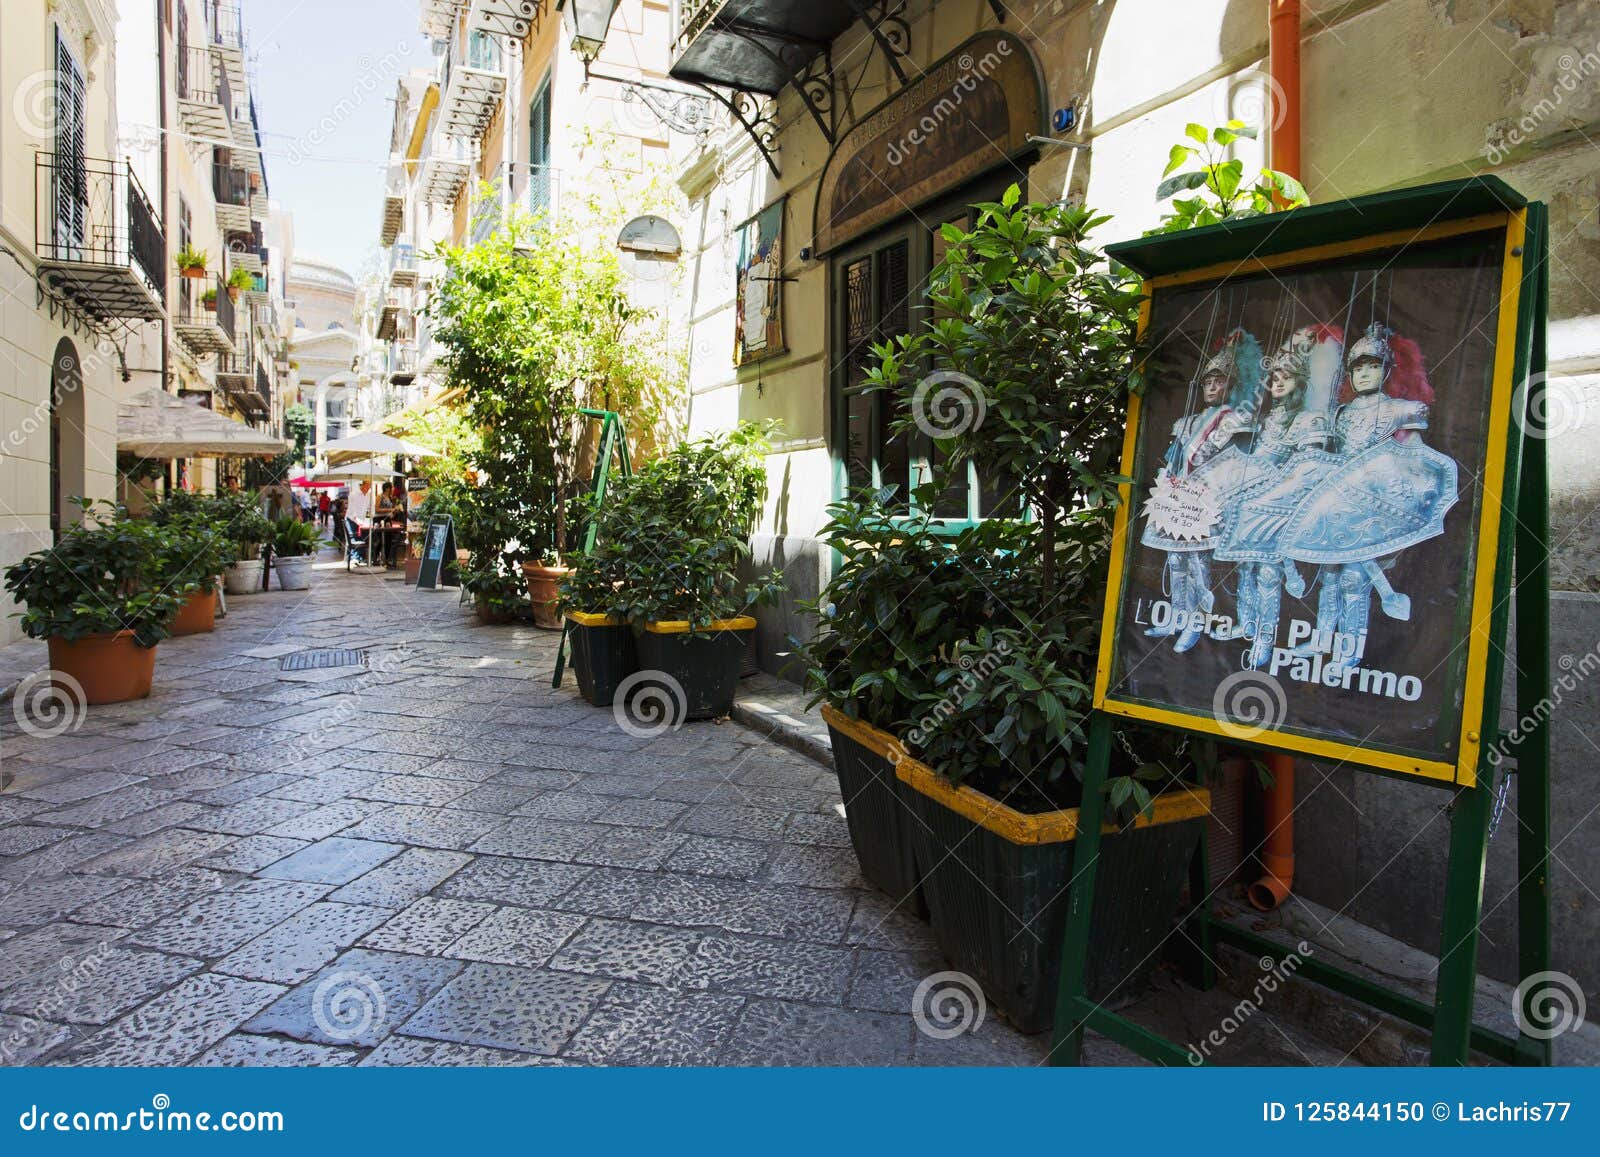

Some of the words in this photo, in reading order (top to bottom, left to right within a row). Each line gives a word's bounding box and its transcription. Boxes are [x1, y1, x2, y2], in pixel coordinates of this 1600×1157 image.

[1134, 597, 1233, 638] L'Opera
[1287, 618, 1369, 662] Pupi
[1269, 646, 1423, 701] Palermo
